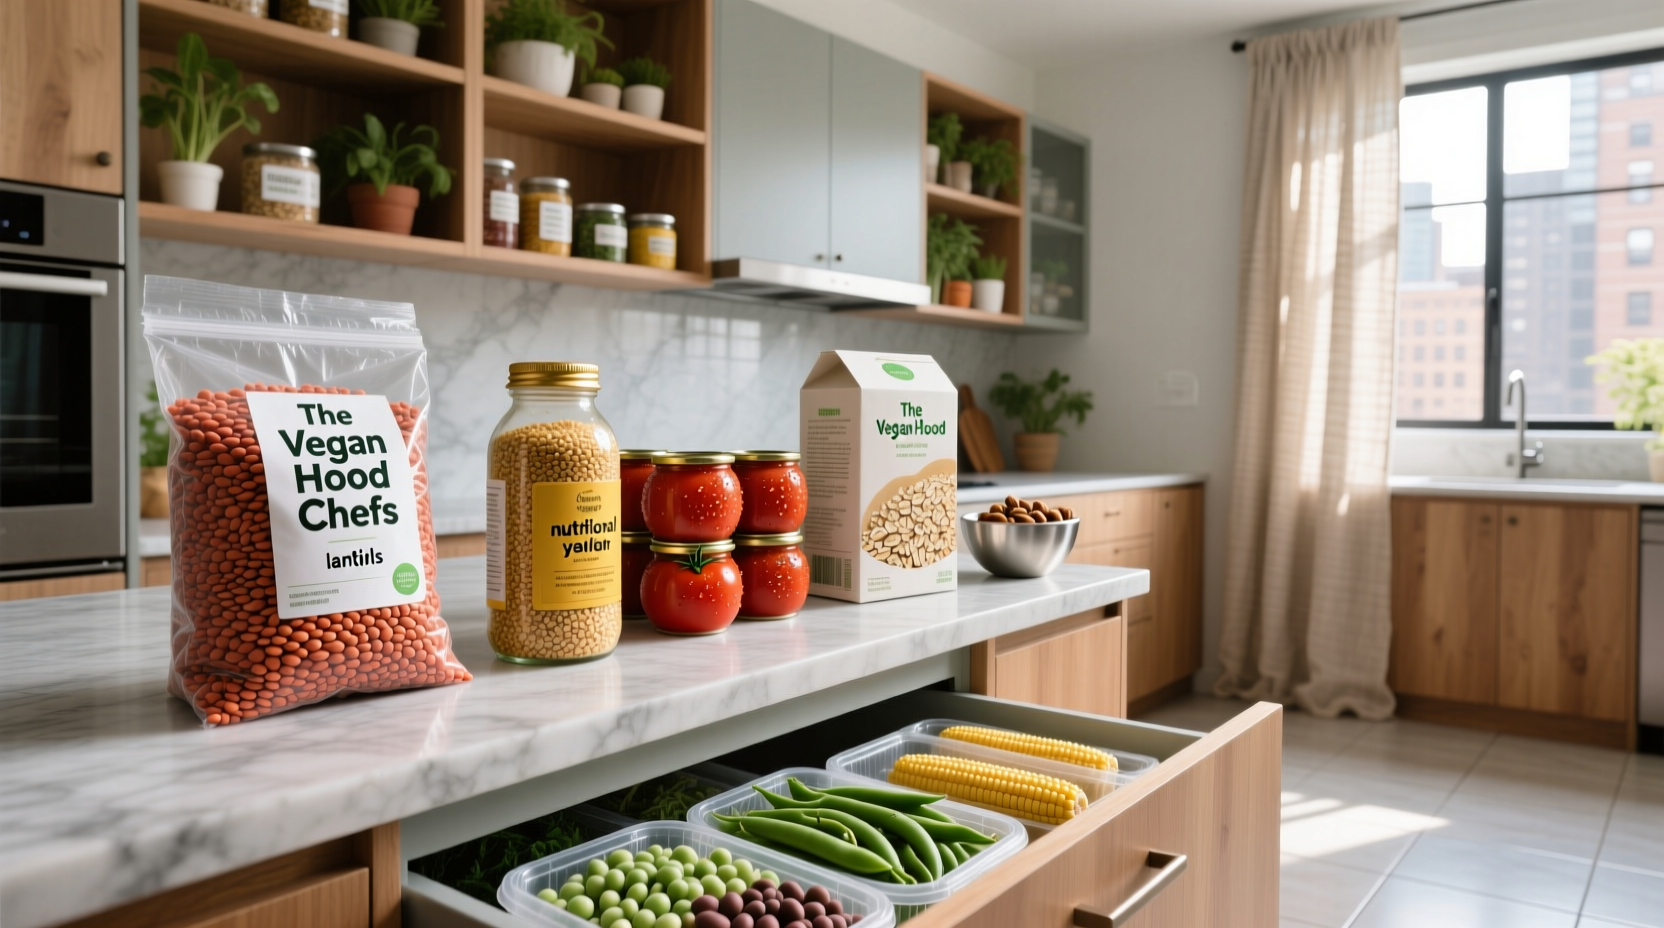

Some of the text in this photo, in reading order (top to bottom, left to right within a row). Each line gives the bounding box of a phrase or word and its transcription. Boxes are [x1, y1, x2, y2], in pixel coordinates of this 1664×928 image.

[296, 403, 353, 425] The
[900, 402, 923, 417] The
[877, 419, 946, 440] Vegan Hood
[278, 430, 388, 464] Vegan
[294, 460, 391, 493] Hood
[298, 495, 399, 532] Chefs
